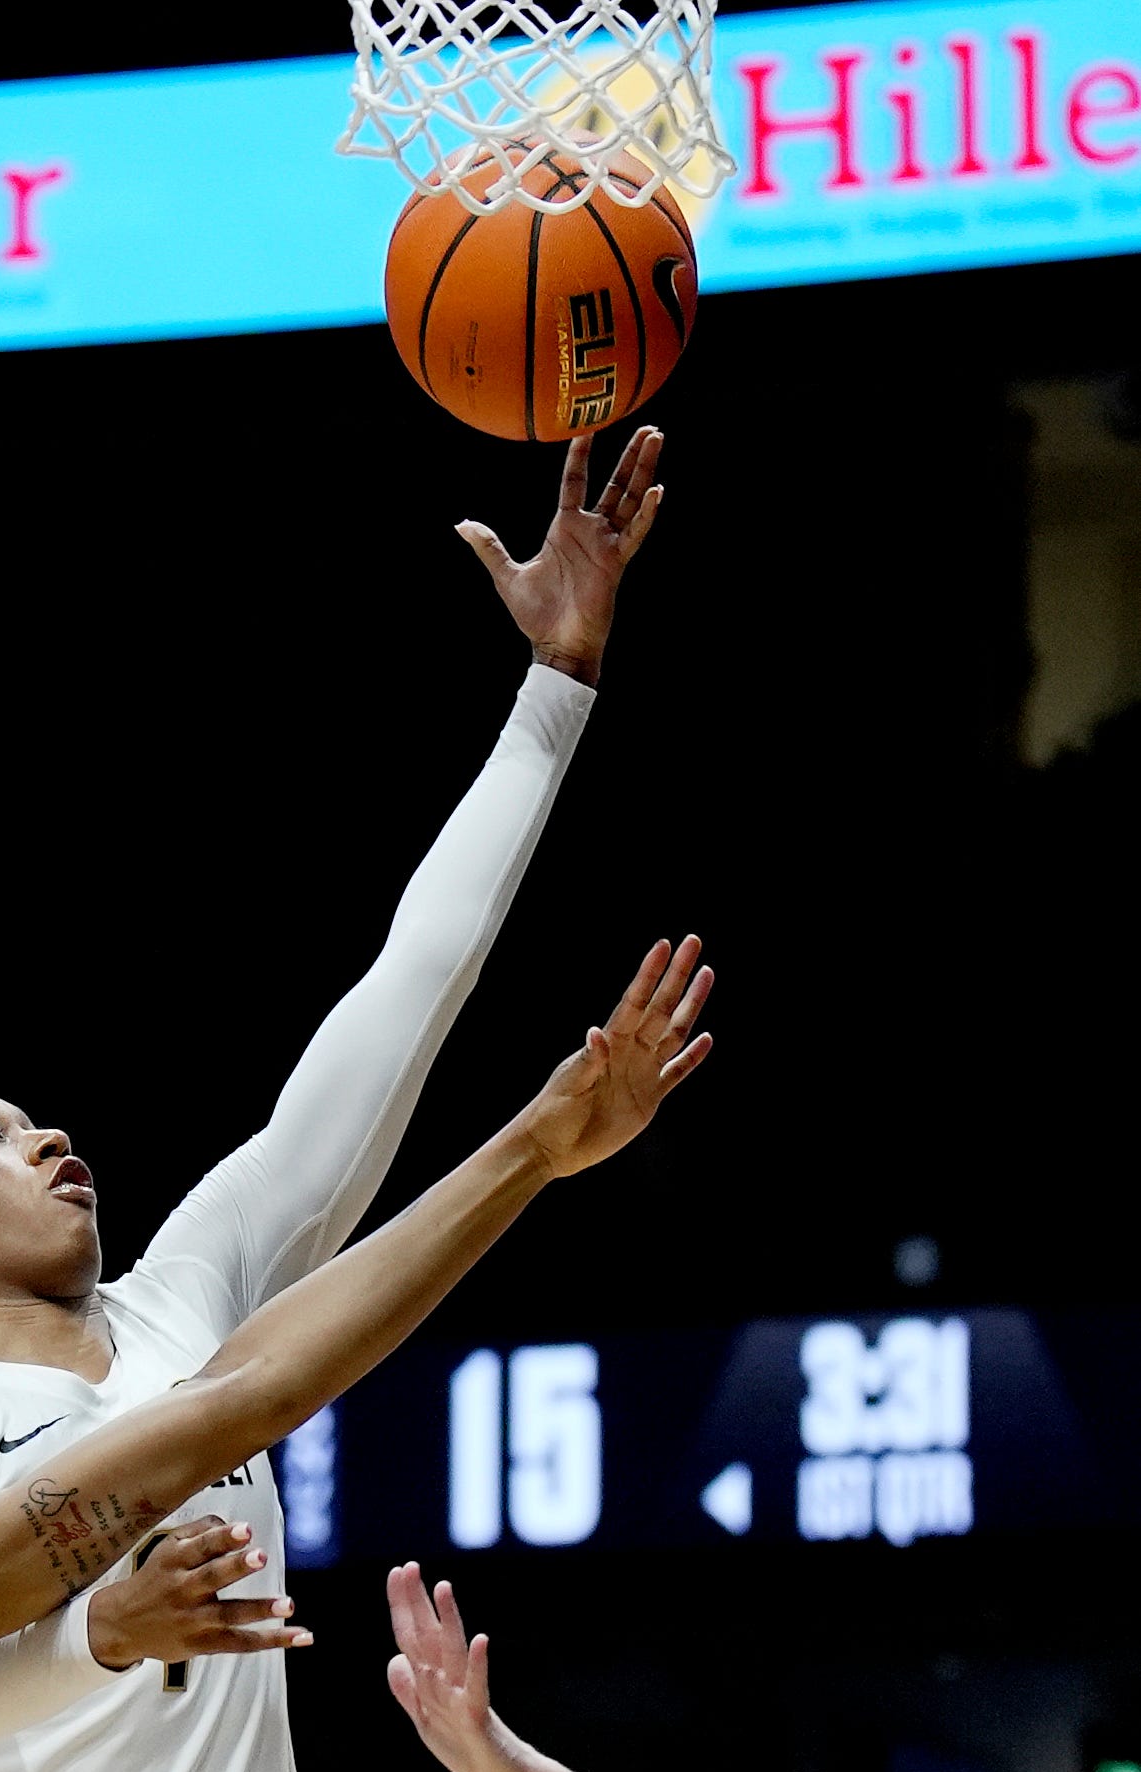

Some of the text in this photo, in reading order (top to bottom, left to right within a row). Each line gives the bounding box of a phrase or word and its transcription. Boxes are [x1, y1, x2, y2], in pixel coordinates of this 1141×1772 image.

[568, 287, 618, 430] ELITE
[448, 1343, 603, 1549] 15
[799, 1316, 971, 1452] 3:31
